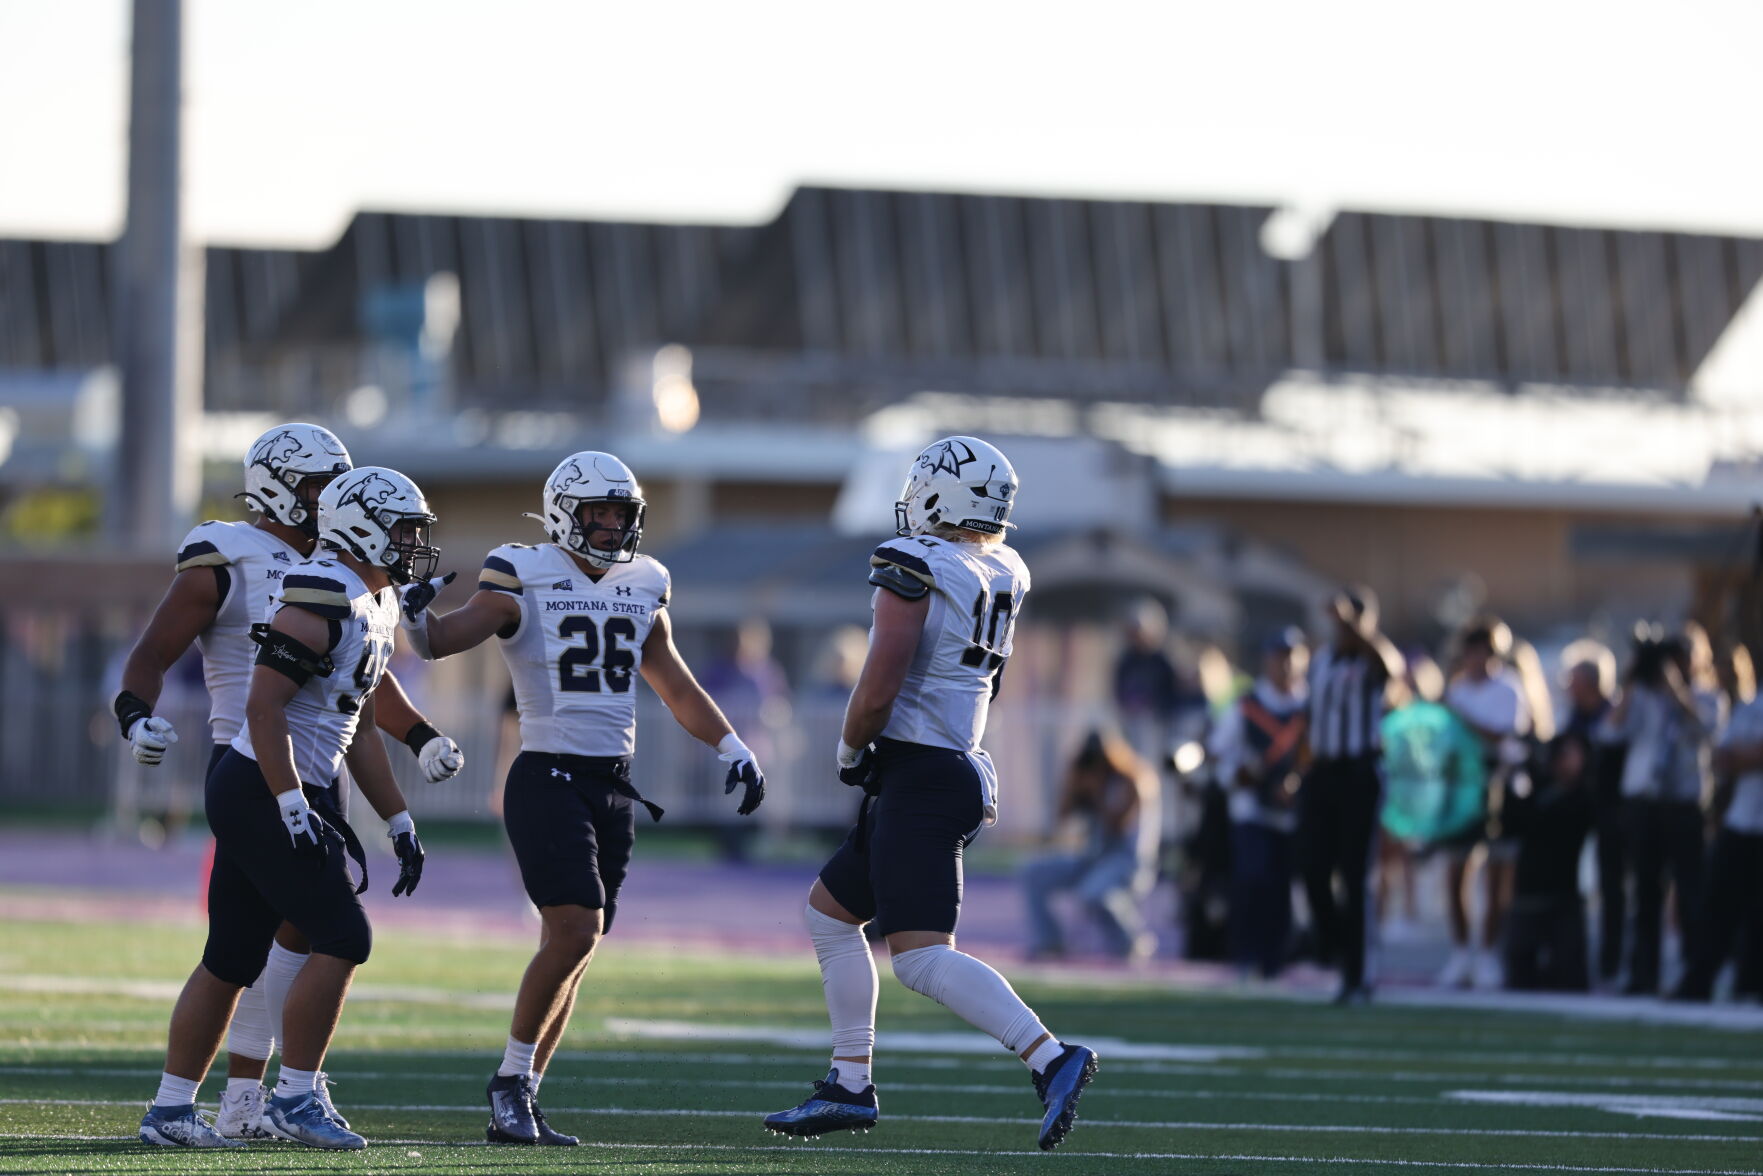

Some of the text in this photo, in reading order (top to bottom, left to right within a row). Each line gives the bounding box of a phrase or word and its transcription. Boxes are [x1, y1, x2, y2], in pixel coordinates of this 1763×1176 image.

[994, 506, 1006, 521] 10
[545, 601, 645, 614] MONTANA STATE
[959, 589, 1013, 671] 10
[558, 614, 636, 694] 26
